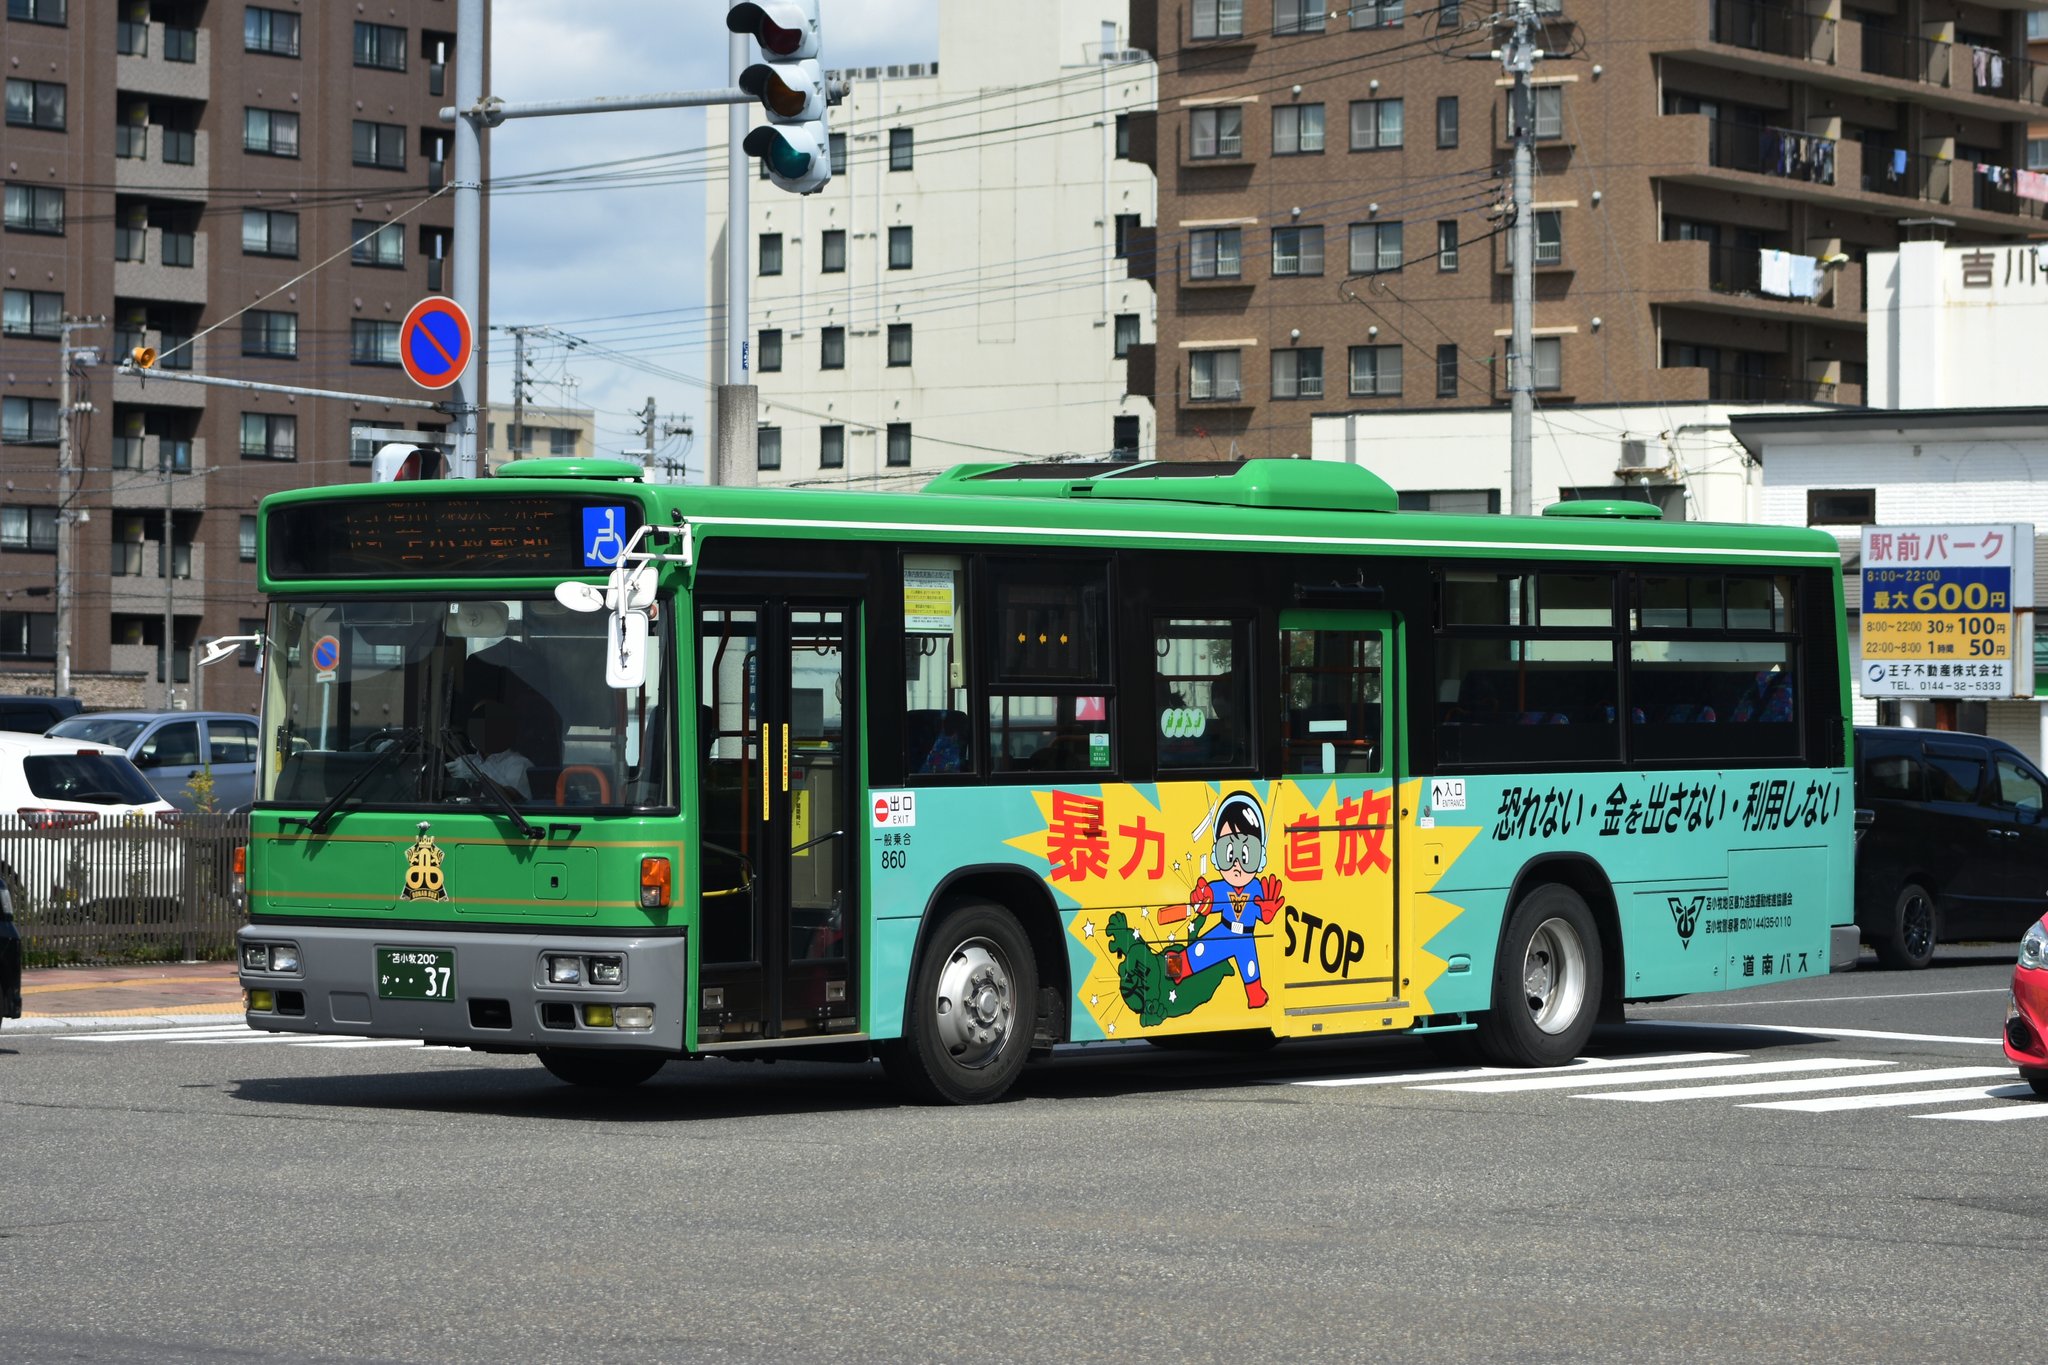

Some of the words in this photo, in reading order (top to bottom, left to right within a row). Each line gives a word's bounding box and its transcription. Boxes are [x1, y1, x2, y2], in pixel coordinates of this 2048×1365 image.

[1869, 531, 2004, 561] 駅前パーク
[1927, 620, 1954, 634] 30分
[1958, 617, 2006, 635] 100円
[1969, 638, 2006, 656] 50円
[1888, 664, 2004, 677] 王子不動産株式会社
[1891, 681, 1914, 690] TEL.
[1920, 681, 2001, 691] 0144-32-5333
[1444, 782, 1463, 796] 入口
[890, 795, 913, 812] 出口
[1442, 799, 1464, 807] ENTRANCE
[892, 815, 910, 824] EXIT
[874, 833, 912, 846] 一般乗合
[881, 850, 906, 869] 860
[1284, 905, 1365, 979] STOP
[1742, 952, 1808, 977] 道南バス
[381, 974, 390, 985] か
[424, 967, 451, 997] 37
